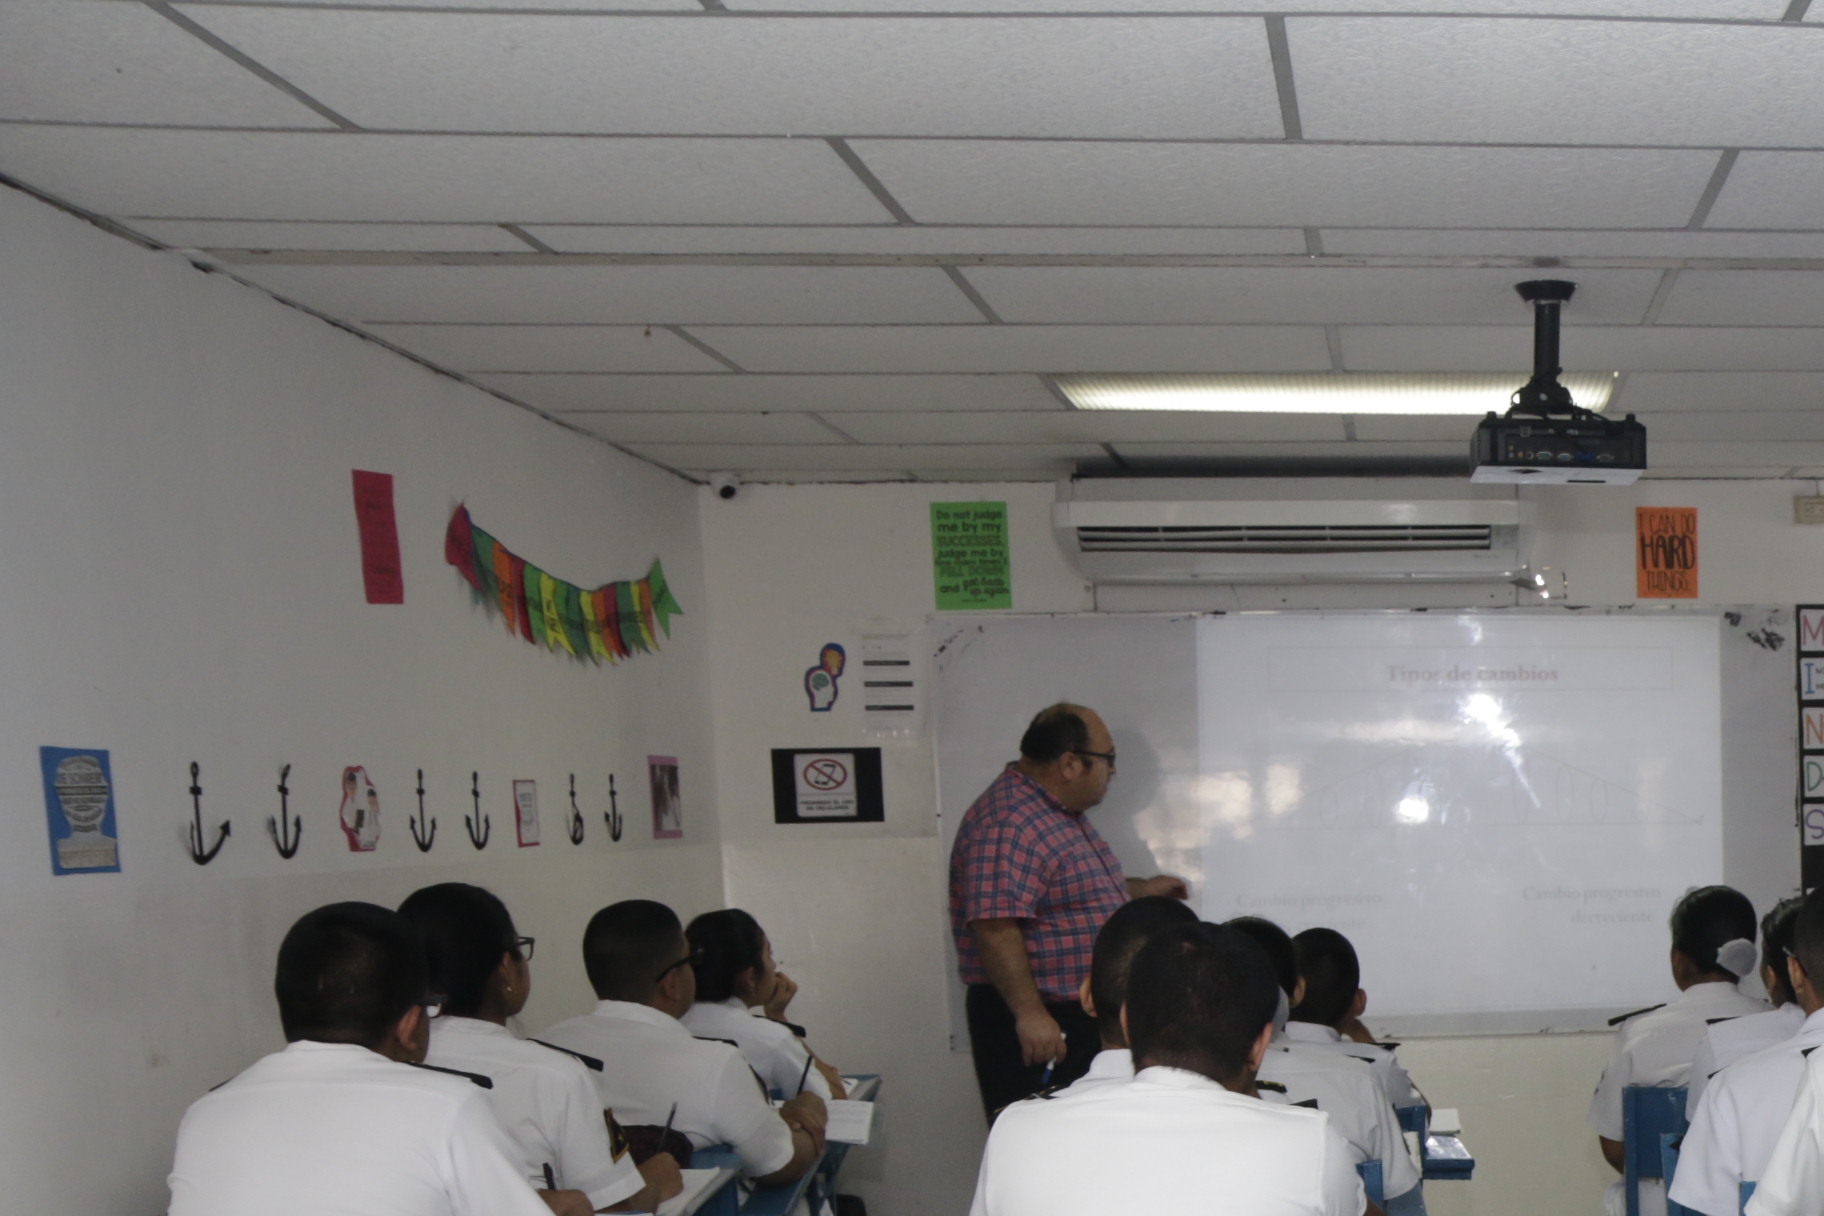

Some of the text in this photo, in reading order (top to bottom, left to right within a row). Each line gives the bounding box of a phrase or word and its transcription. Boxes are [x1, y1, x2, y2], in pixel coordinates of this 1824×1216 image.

[1648, 513, 1676, 534] CAN
[1640, 532, 1696, 570] HARD
[1386, 665, 1559, 687] Tipos de cambios
[1806, 713, 1824, 744] N
[1806, 761, 1822, 792] D
